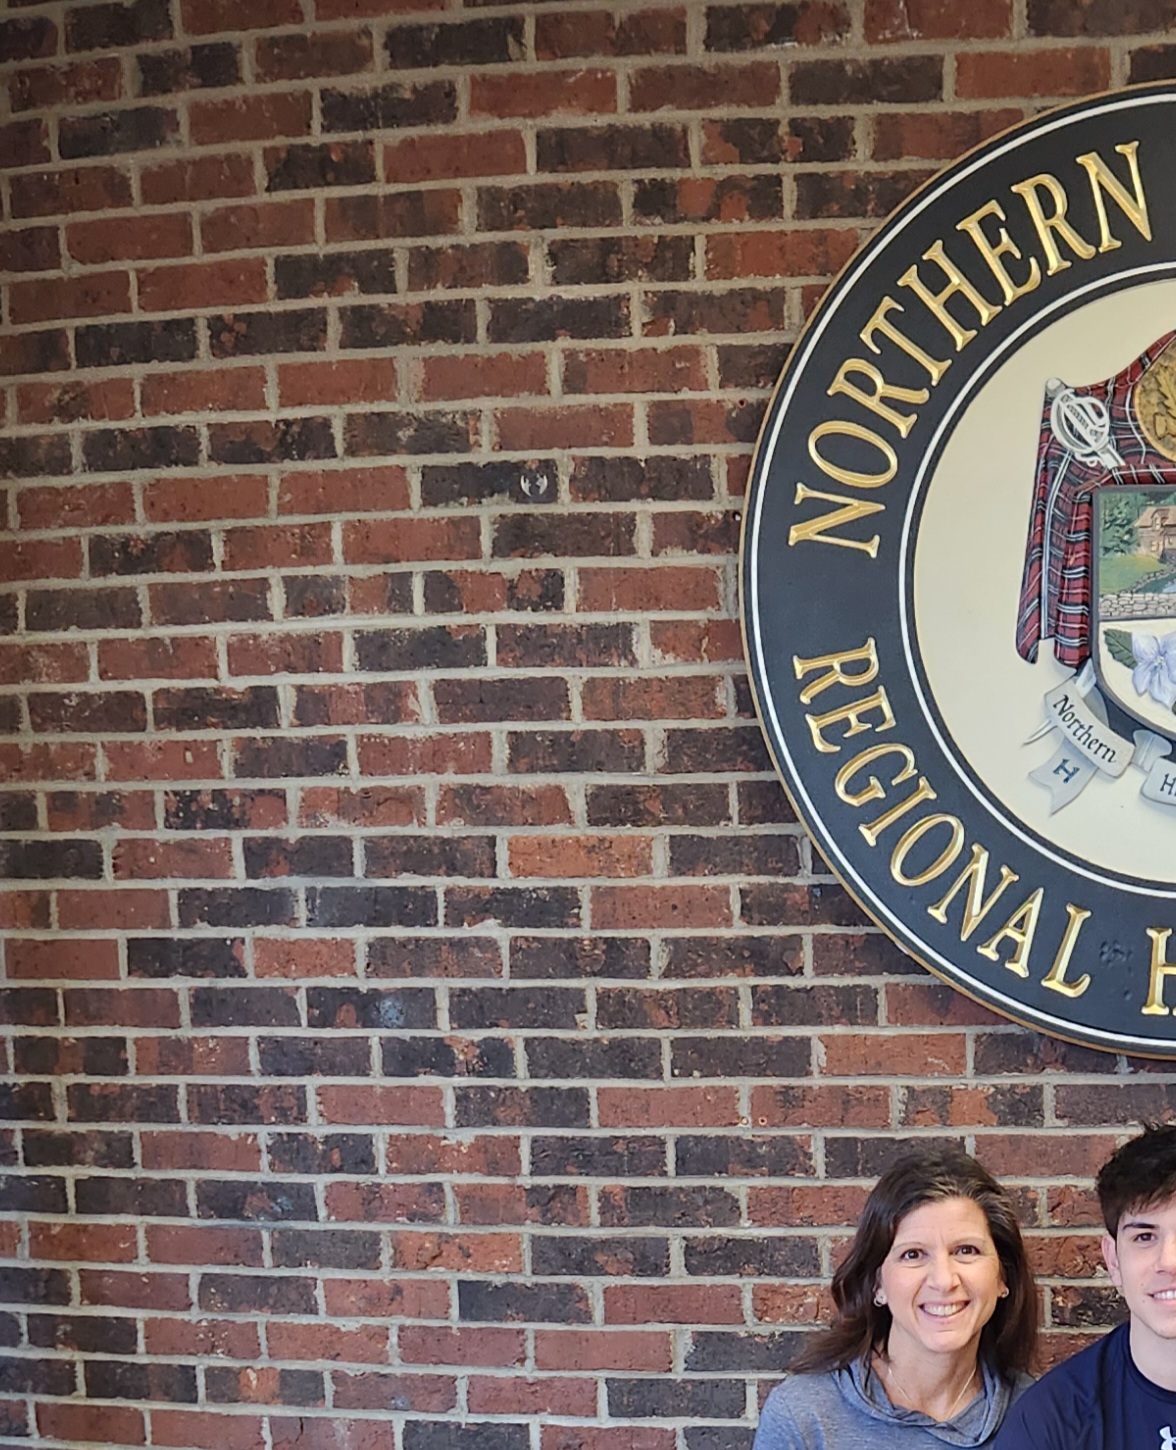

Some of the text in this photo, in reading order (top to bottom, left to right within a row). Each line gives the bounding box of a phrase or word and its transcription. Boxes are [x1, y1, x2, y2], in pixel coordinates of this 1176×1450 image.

[787, 139, 1153, 558] NORTHERN
[793, 636, 1092, 998] REGIONAL
[1052, 694, 1118, 765] Northern
